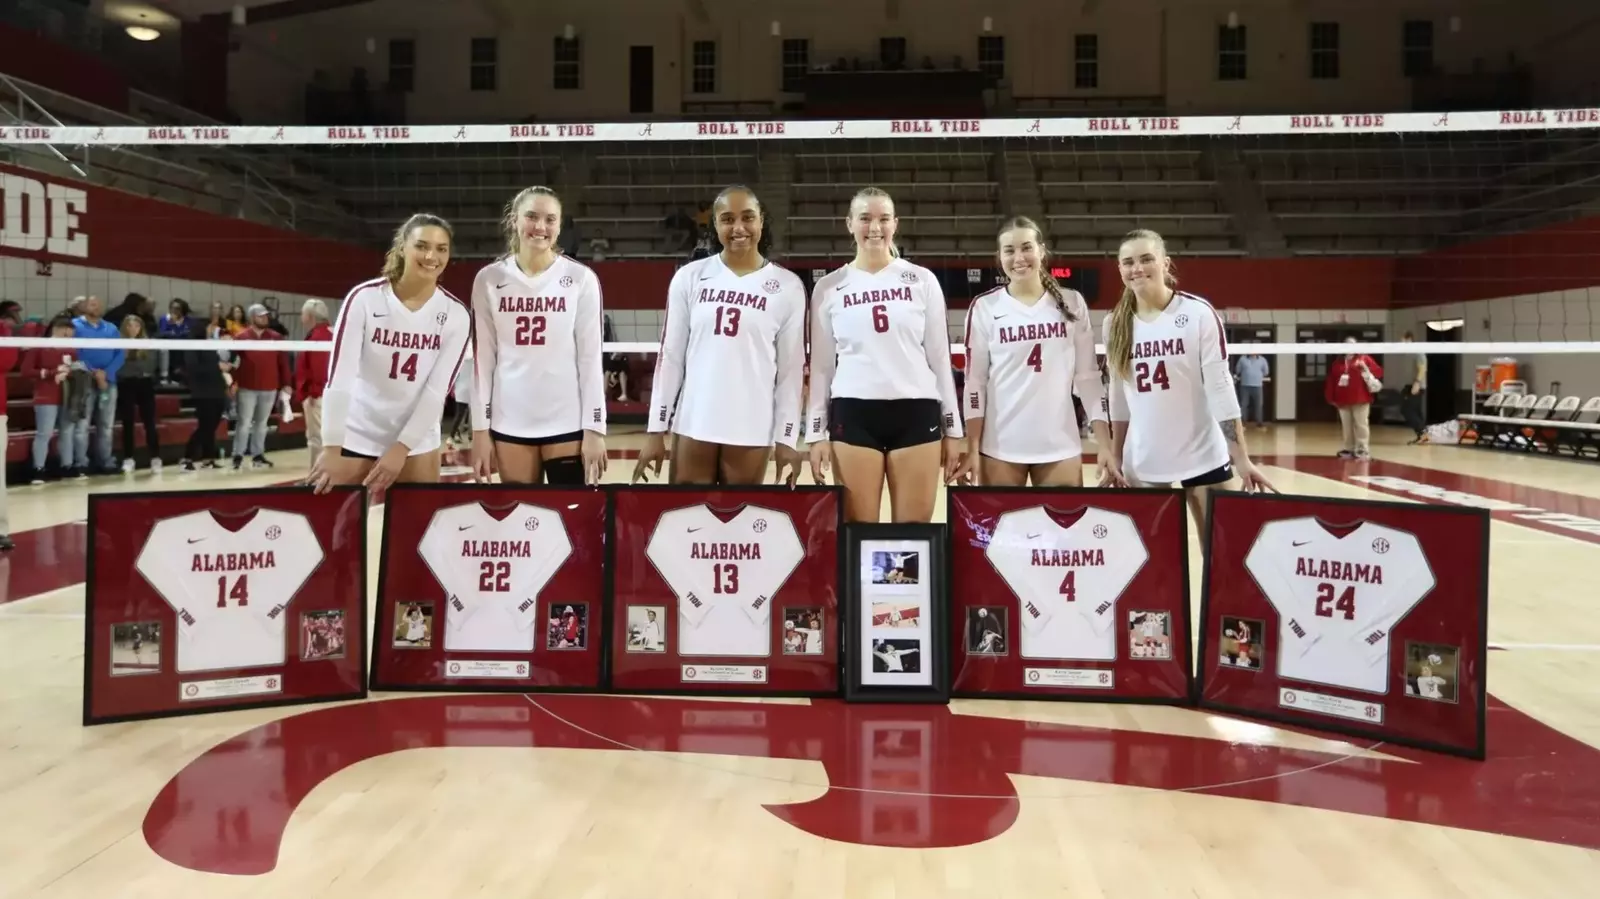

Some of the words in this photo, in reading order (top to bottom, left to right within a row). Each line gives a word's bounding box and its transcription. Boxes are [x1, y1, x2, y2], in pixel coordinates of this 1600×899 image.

[1089, 119, 1130, 130] ROLL
[1138, 118, 1179, 130] TIDE
[1291, 116, 1333, 127] ROLL
[1343, 115, 1384, 127] TIDE
[1500, 112, 1545, 124] ROLL
[1554, 110, 1598, 122] TIDE
[14, 128, 50, 139] TIDE
[148, 129, 185, 139] ROLL
[193, 129, 229, 139] TIDE
[328, 128, 365, 138] ROLL
[373, 128, 409, 138] TIDE
[511, 126, 549, 136] ROLL
[557, 125, 595, 136] TIDE
[698, 122, 738, 134] ROLL
[746, 122, 785, 134] TIDE
[892, 121, 932, 132] ROLL
[941, 121, 979, 132] TIDE
[0, 172, 88, 258] DE
[499, 297, 566, 312] ALABAMA
[699, 287, 767, 311] ALABAMA
[843, 286, 912, 308] ALABAMA
[714, 306, 741, 337] 13
[873, 305, 889, 333] 6
[372, 327, 441, 350] ALABAMA
[516, 316, 546, 345] 22
[1000, 321, 1067, 343] ALABAMA
[389, 352, 418, 381] 14
[1027, 344, 1042, 372] 4
[1136, 361, 1170, 392] 24
[971, 392, 979, 409] ROLL
[813, 417, 821, 432] ROLL
[945, 412, 954, 428] TIDE
[784, 422, 794, 438] TIDE
[462, 540, 530, 557] ALABAMA
[691, 543, 760, 560] ALABAMA
[192, 551, 275, 571] ALABAMA
[1032, 549, 1104, 566] ALABAMA
[479, 562, 510, 592] 22
[714, 564, 738, 594] 13
[1295, 557, 1383, 584] ALABAMA
[217, 575, 248, 607] 14
[1060, 571, 1075, 601] 4
[450, 594, 464, 611] ROLL
[518, 598, 534, 613] TIDE
[687, 592, 702, 607] ROLL
[752, 595, 766, 609] TIDE
[1316, 583, 1355, 620] 24
[178, 607, 196, 627] ROLL
[266, 604, 285, 620] TIDE
[1026, 601, 1040, 618] ROLL
[1095, 601, 1112, 616] TIDE
[1289, 619, 1305, 638] ROLL
[1365, 630, 1385, 645] TIDE
